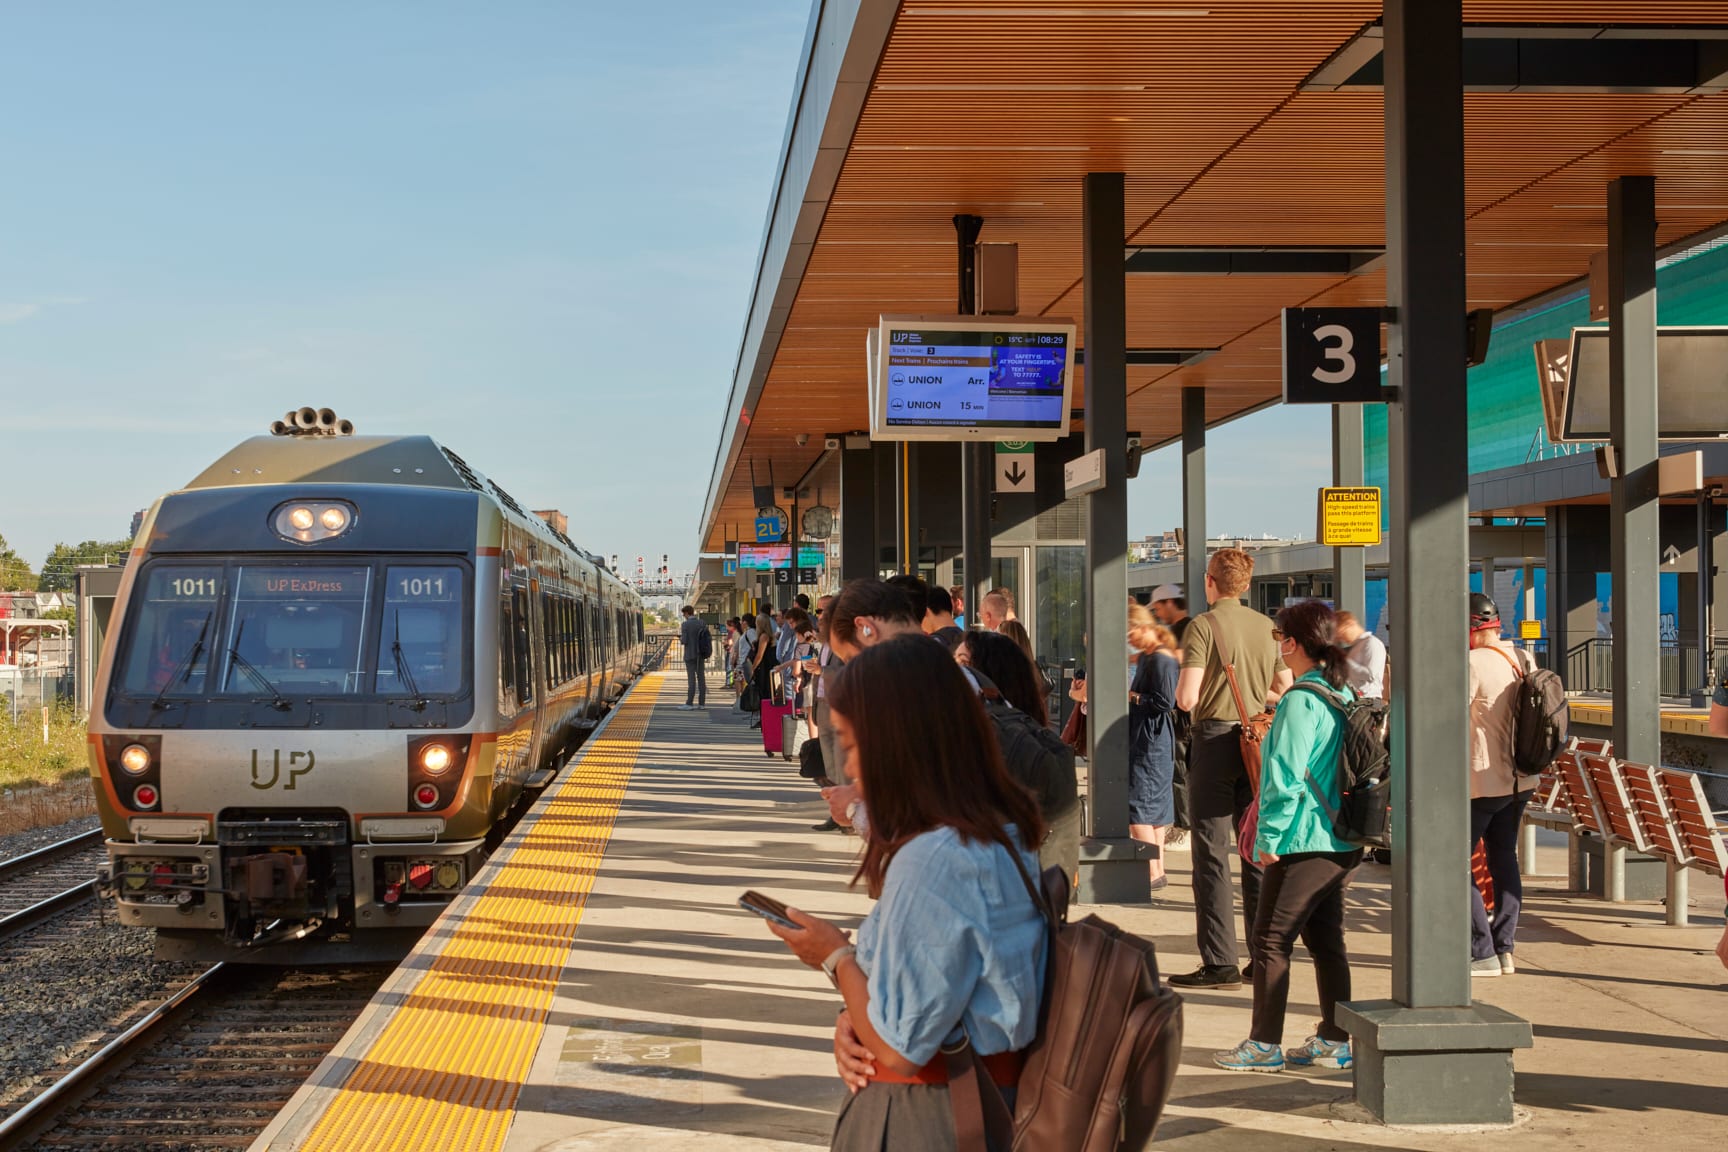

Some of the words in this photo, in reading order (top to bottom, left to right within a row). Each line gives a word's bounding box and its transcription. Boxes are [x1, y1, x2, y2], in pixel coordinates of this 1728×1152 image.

[893, 332, 909, 343] UP
[1040, 336, 1064, 344] 08:29
[1311, 324, 1356, 384] 3
[908, 376, 943, 385] UNION
[967, 377, 985, 385] Arr.
[907, 401, 942, 409] UNION
[960, 401, 971, 410] 15
[1326, 492, 1378, 501] ATTENTION
[757, 522, 779, 537] 2L
[779, 570, 789, 582] 3
[172, 578, 217, 596] 1011
[266, 579, 289, 592] UP
[400, 578, 444, 596] 1011
[649, 636, 656, 644] U
[250, 748, 316, 791] UP
